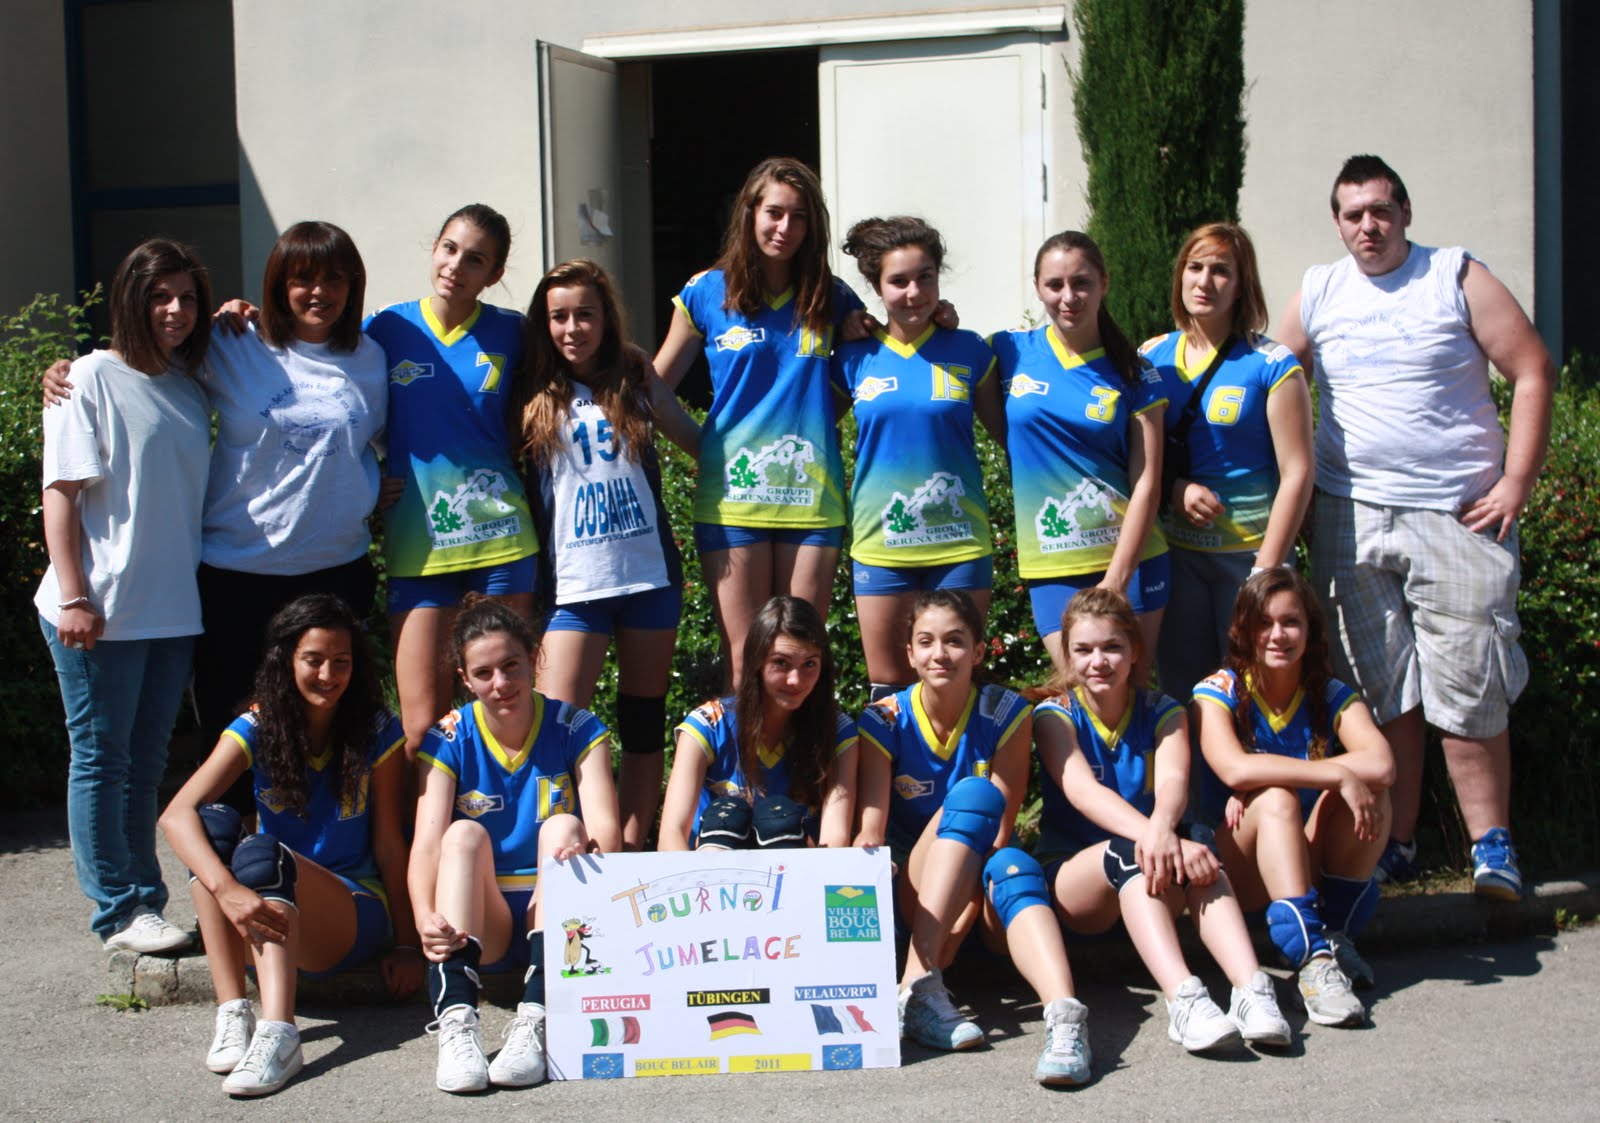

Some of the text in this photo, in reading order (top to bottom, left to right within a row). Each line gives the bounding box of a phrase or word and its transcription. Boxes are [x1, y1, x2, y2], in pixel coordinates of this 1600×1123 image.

[476, 352, 507, 394] 7
[931, 363, 971, 404] 15
[1085, 385, 1121, 424] 3
[1206, 386, 1246, 426] 6
[572, 419, 620, 466] 15
[727, 493, 771, 502] SERENA
[767, 487, 811, 496] GROUPE
[574, 476, 647, 538] COBAMA
[473, 517, 518, 532] GROUPE
[926, 522, 969, 534] GROUPE
[433, 533, 480, 548] SERENA
[886, 535, 932, 546] SERENA
[1042, 535, 1119, 552] SERENA SANT
[535, 771, 575, 823] 13
[828, 907, 877, 916] VILLE DE
[828, 916, 878, 928] BOUC
[830, 929, 879, 938] BEL AIR
[635, 935, 801, 976] JUMELAGE
[687, 990, 762, 1006] TÜBINGEN
[795, 986, 876, 1000] VELAUX/RPV
[582, 997, 647, 1011] PERUGIA
[635, 1058, 717, 1072] BOUC BEL AIR
[755, 1058, 780, 1070] 2011
